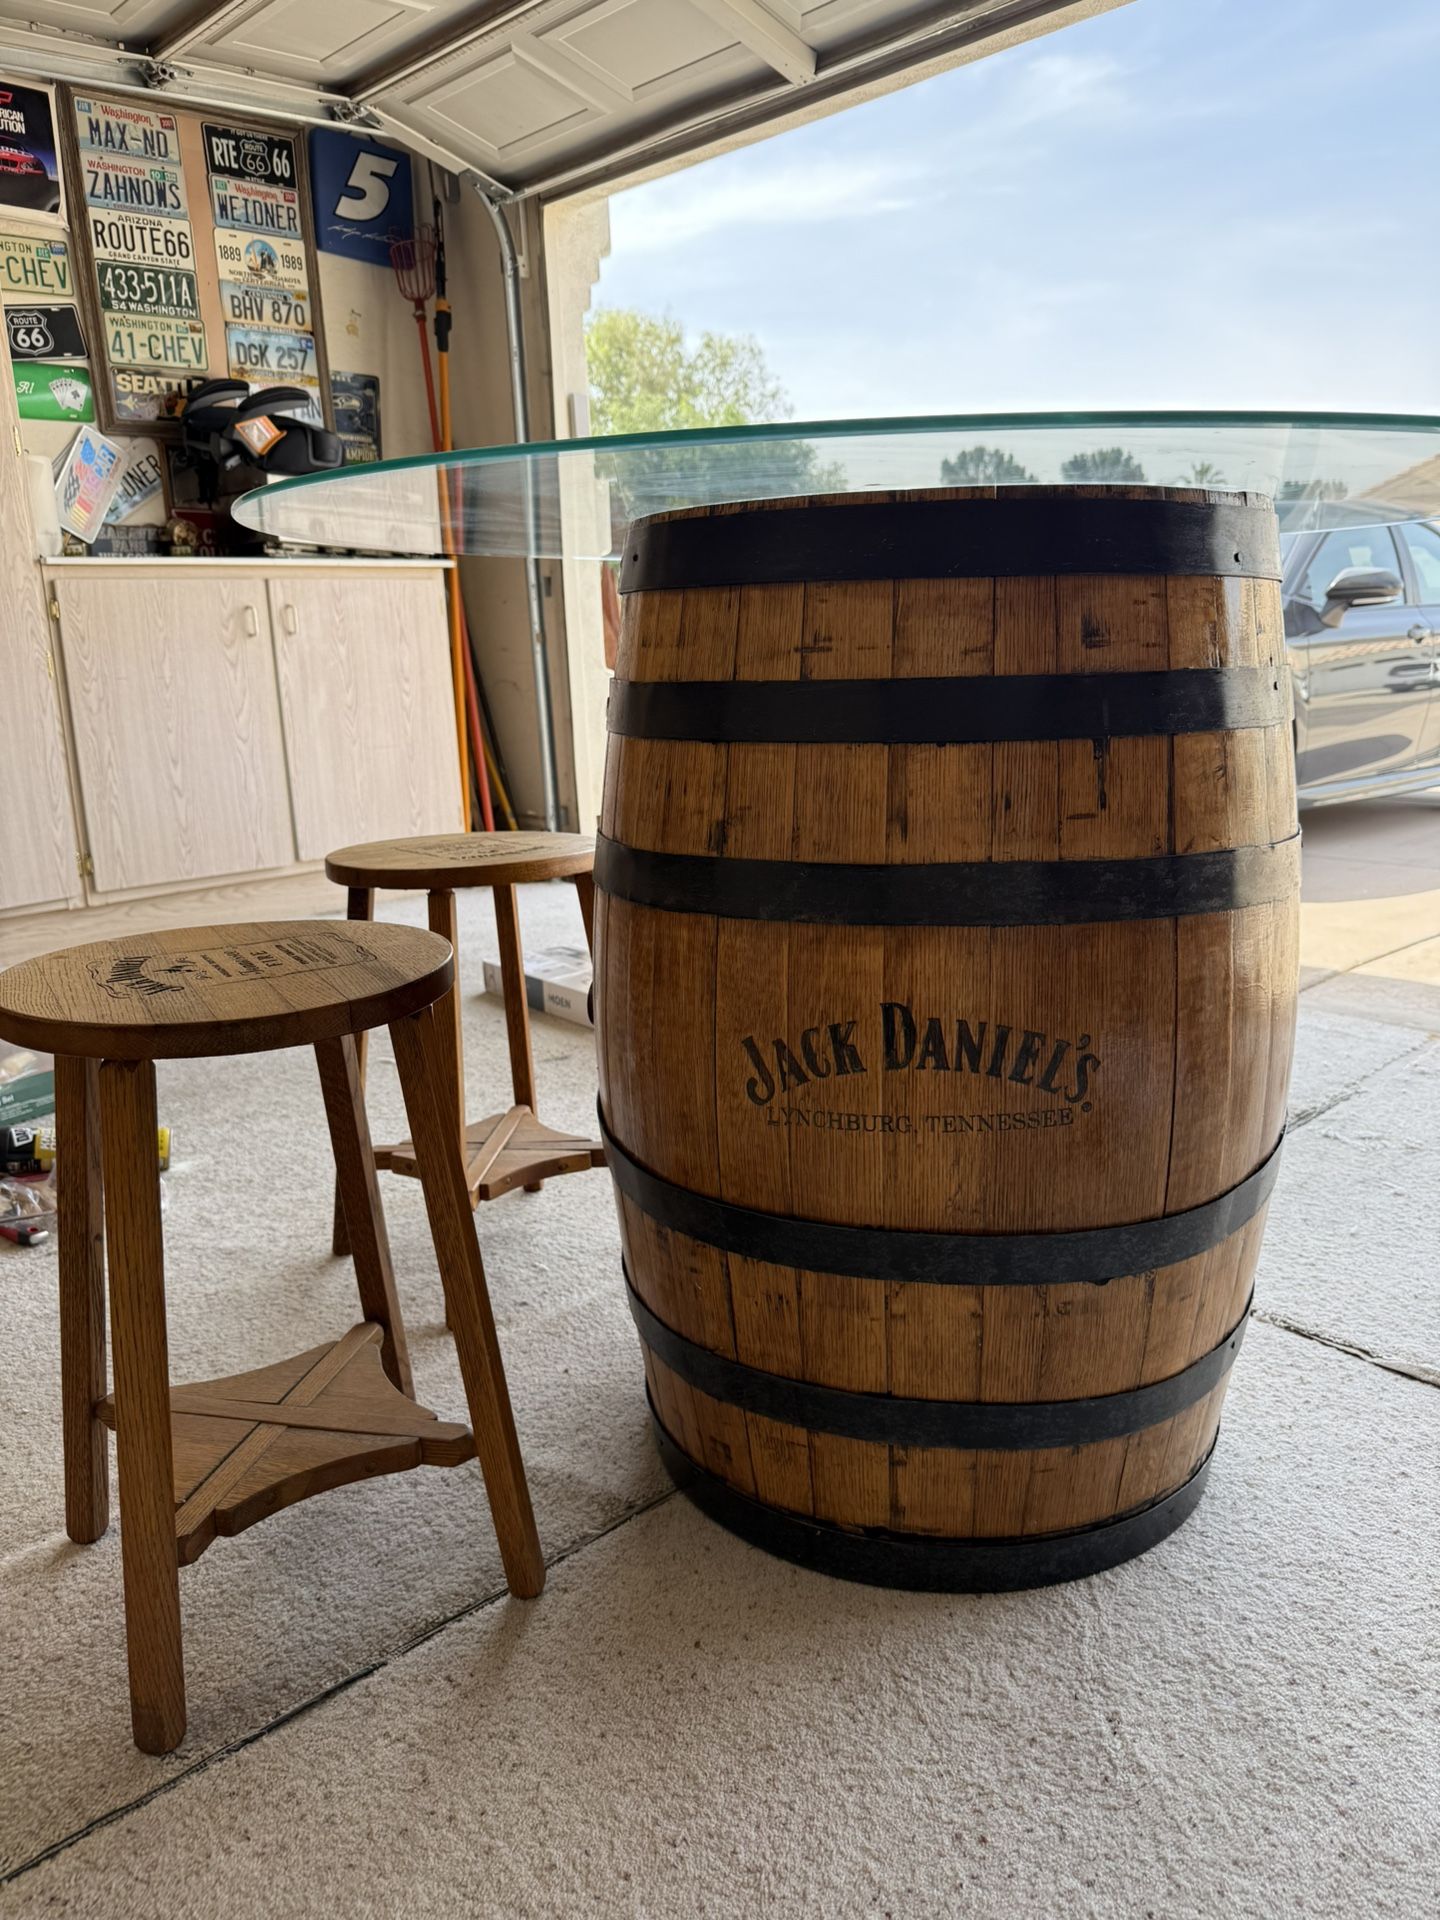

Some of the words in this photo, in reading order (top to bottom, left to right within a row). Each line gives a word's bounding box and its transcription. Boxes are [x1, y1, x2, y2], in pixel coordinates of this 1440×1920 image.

[101, 106, 154, 127] Washington
[88, 117, 168, 158] MAX-ND
[211, 137, 239, 170] RTE
[246, 154, 265, 172] 66
[272, 148, 291, 178] 66
[87, 159, 146, 177] WASHINGTON
[87, 169, 181, 210] ZAHNOWS
[333, 149, 399, 222] 5
[117, 214, 164, 228] ARIZONA
[217, 193, 298, 232] WEIDNER
[93, 219, 190, 259] ROUTE66
[108, 251, 131, 260] GRAND
[132, 254, 160, 264] CANYON
[160, 258, 181, 266] STATE
[218, 244, 242, 262] 1889
[280, 254, 303, 271] 1989
[13, 317, 39, 325] ROUTE
[111, 300, 128, 311] 54
[127, 301, 197, 318] WASHINGTON
[230, 294, 264, 322] BHV
[271, 299, 306, 327] 870
[16, 327, 45, 349] 66
[108, 317, 174, 332] WASHINGTON
[111, 330, 204, 365] 41-CHEV
[235, 341, 271, 369] DGK
[275, 345, 308, 372] 257
[741, 1020, 867, 1106] JACK
[880, 1002, 1100, 1103] DANIEL'S
[926, 1107, 1074, 1134] TENNESSEE
